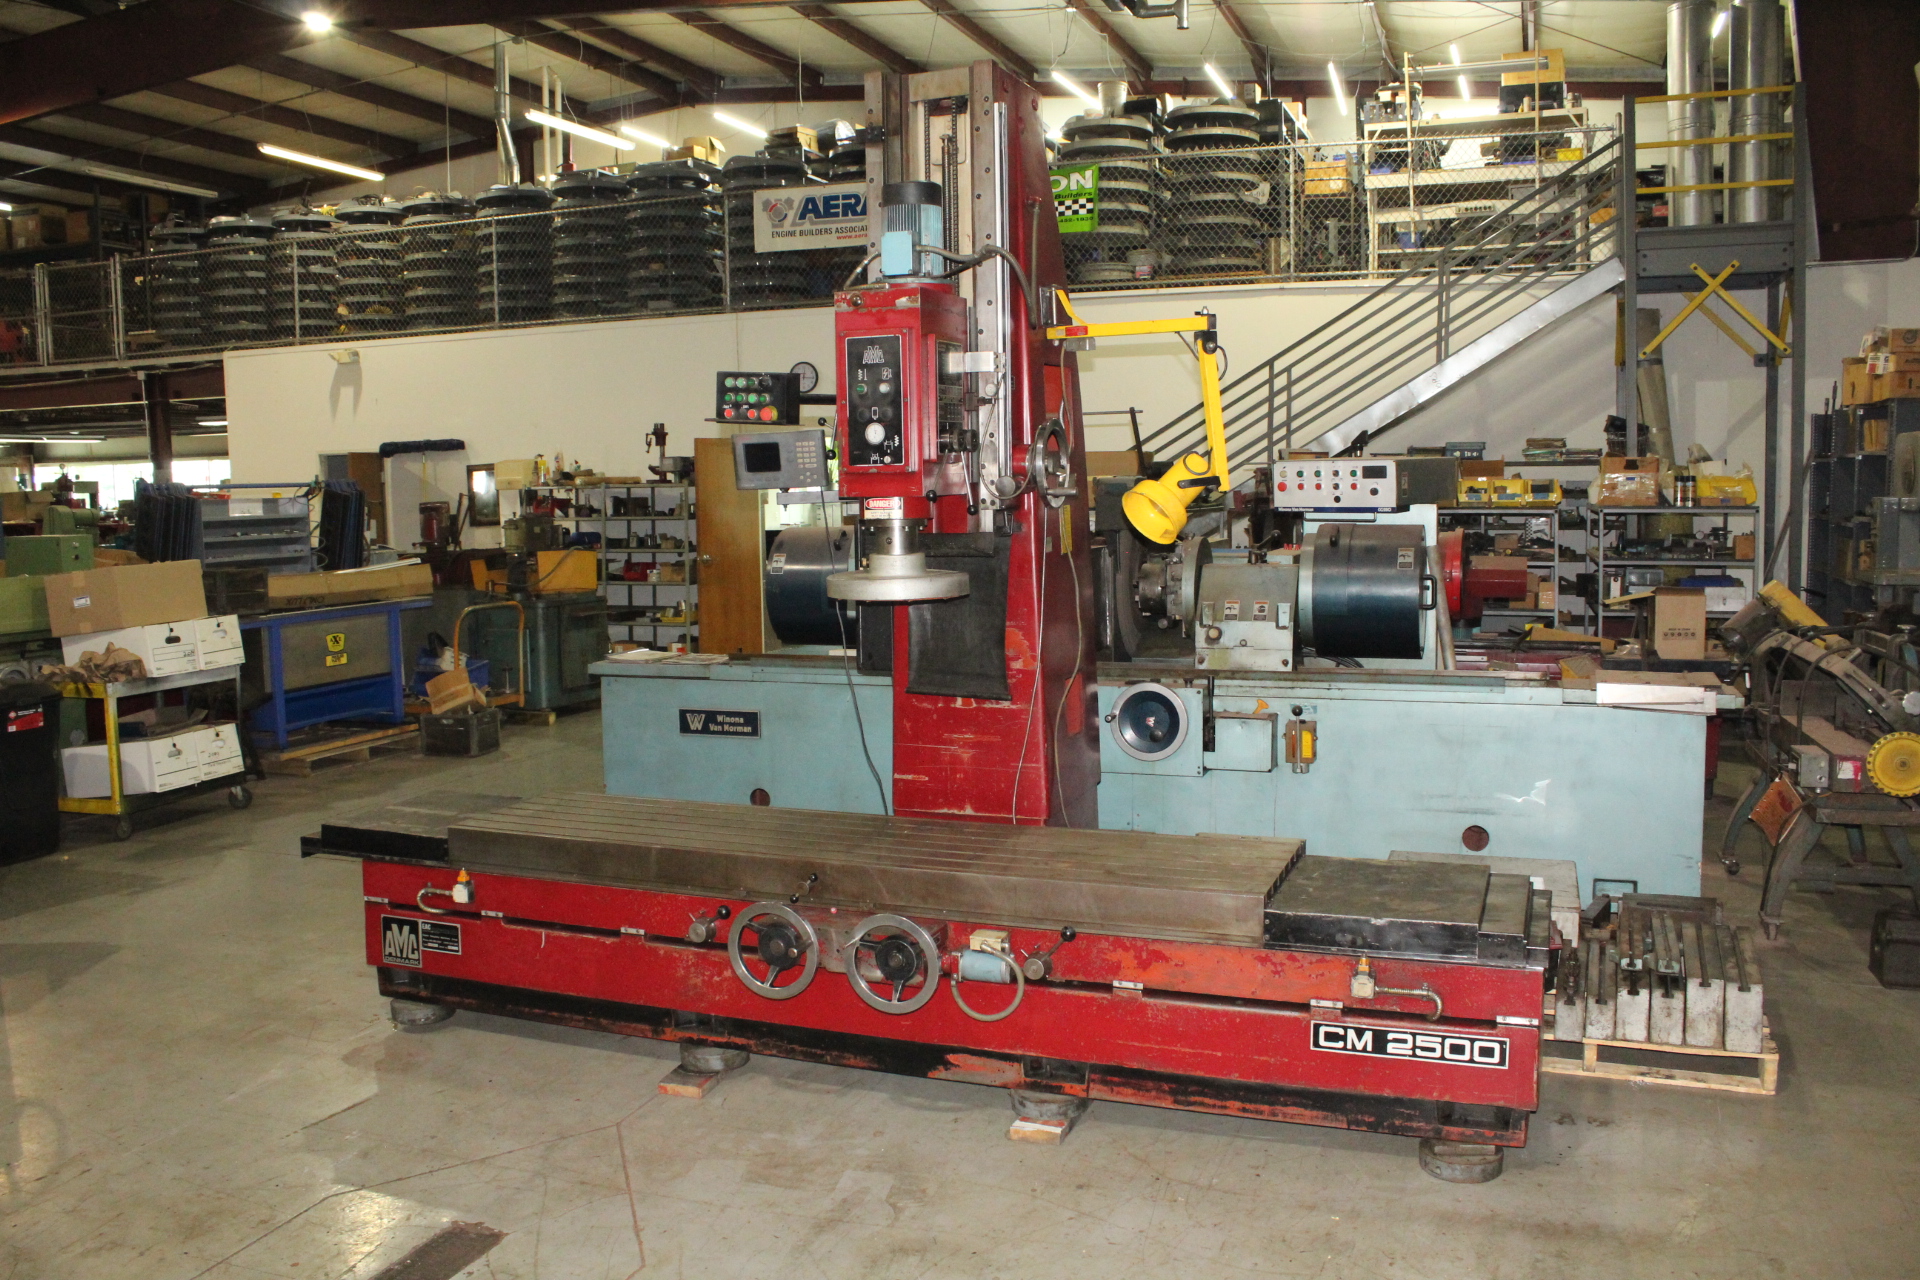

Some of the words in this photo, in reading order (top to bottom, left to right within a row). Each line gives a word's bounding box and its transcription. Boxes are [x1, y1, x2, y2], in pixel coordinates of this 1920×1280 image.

[771, 229, 797, 238] ENGINE
[799, 227, 833, 236] BUILDERS
[869, 500, 897, 508] DANGER
[716, 714, 744, 723] Winona
[709, 723, 723, 731] Van
[723, 724, 752, 732] Norman
[384, 923, 419, 959] AMC
[384, 956, 420, 965] DENMARK
[1318, 1025, 1373, 1052] CM
[1386, 1032, 1501, 1064] 2500
